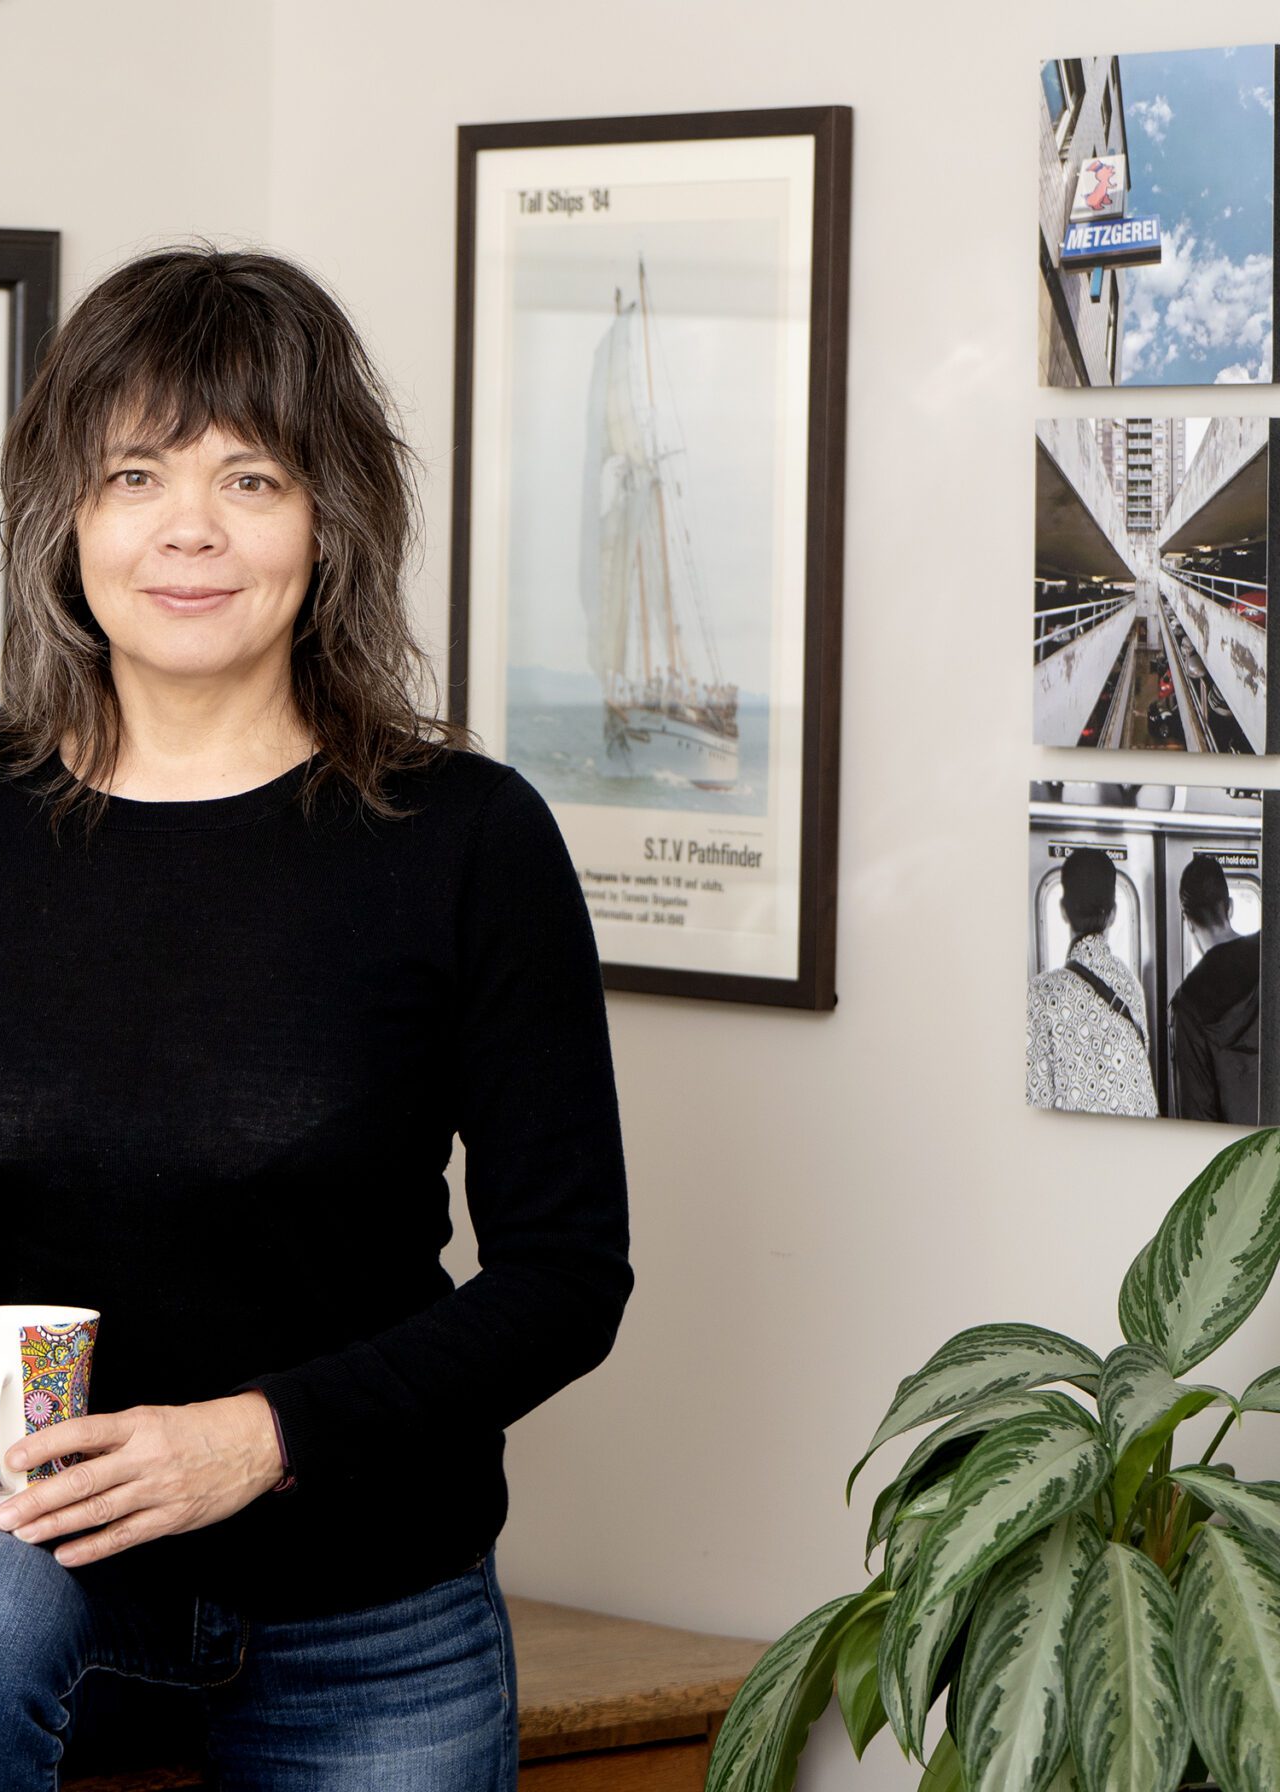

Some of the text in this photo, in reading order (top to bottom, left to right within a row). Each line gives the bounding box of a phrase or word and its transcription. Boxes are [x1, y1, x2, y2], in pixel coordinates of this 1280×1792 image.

[518, 190, 542, 214] Tall
[547, 189, 584, 218] Ships
[1067, 220, 1158, 250] METZGEREI
[643, 837, 763, 868] S.T.V Pathfinder
[1226, 856, 1239, 865] hold
[1240, 856, 1256, 865] doors
